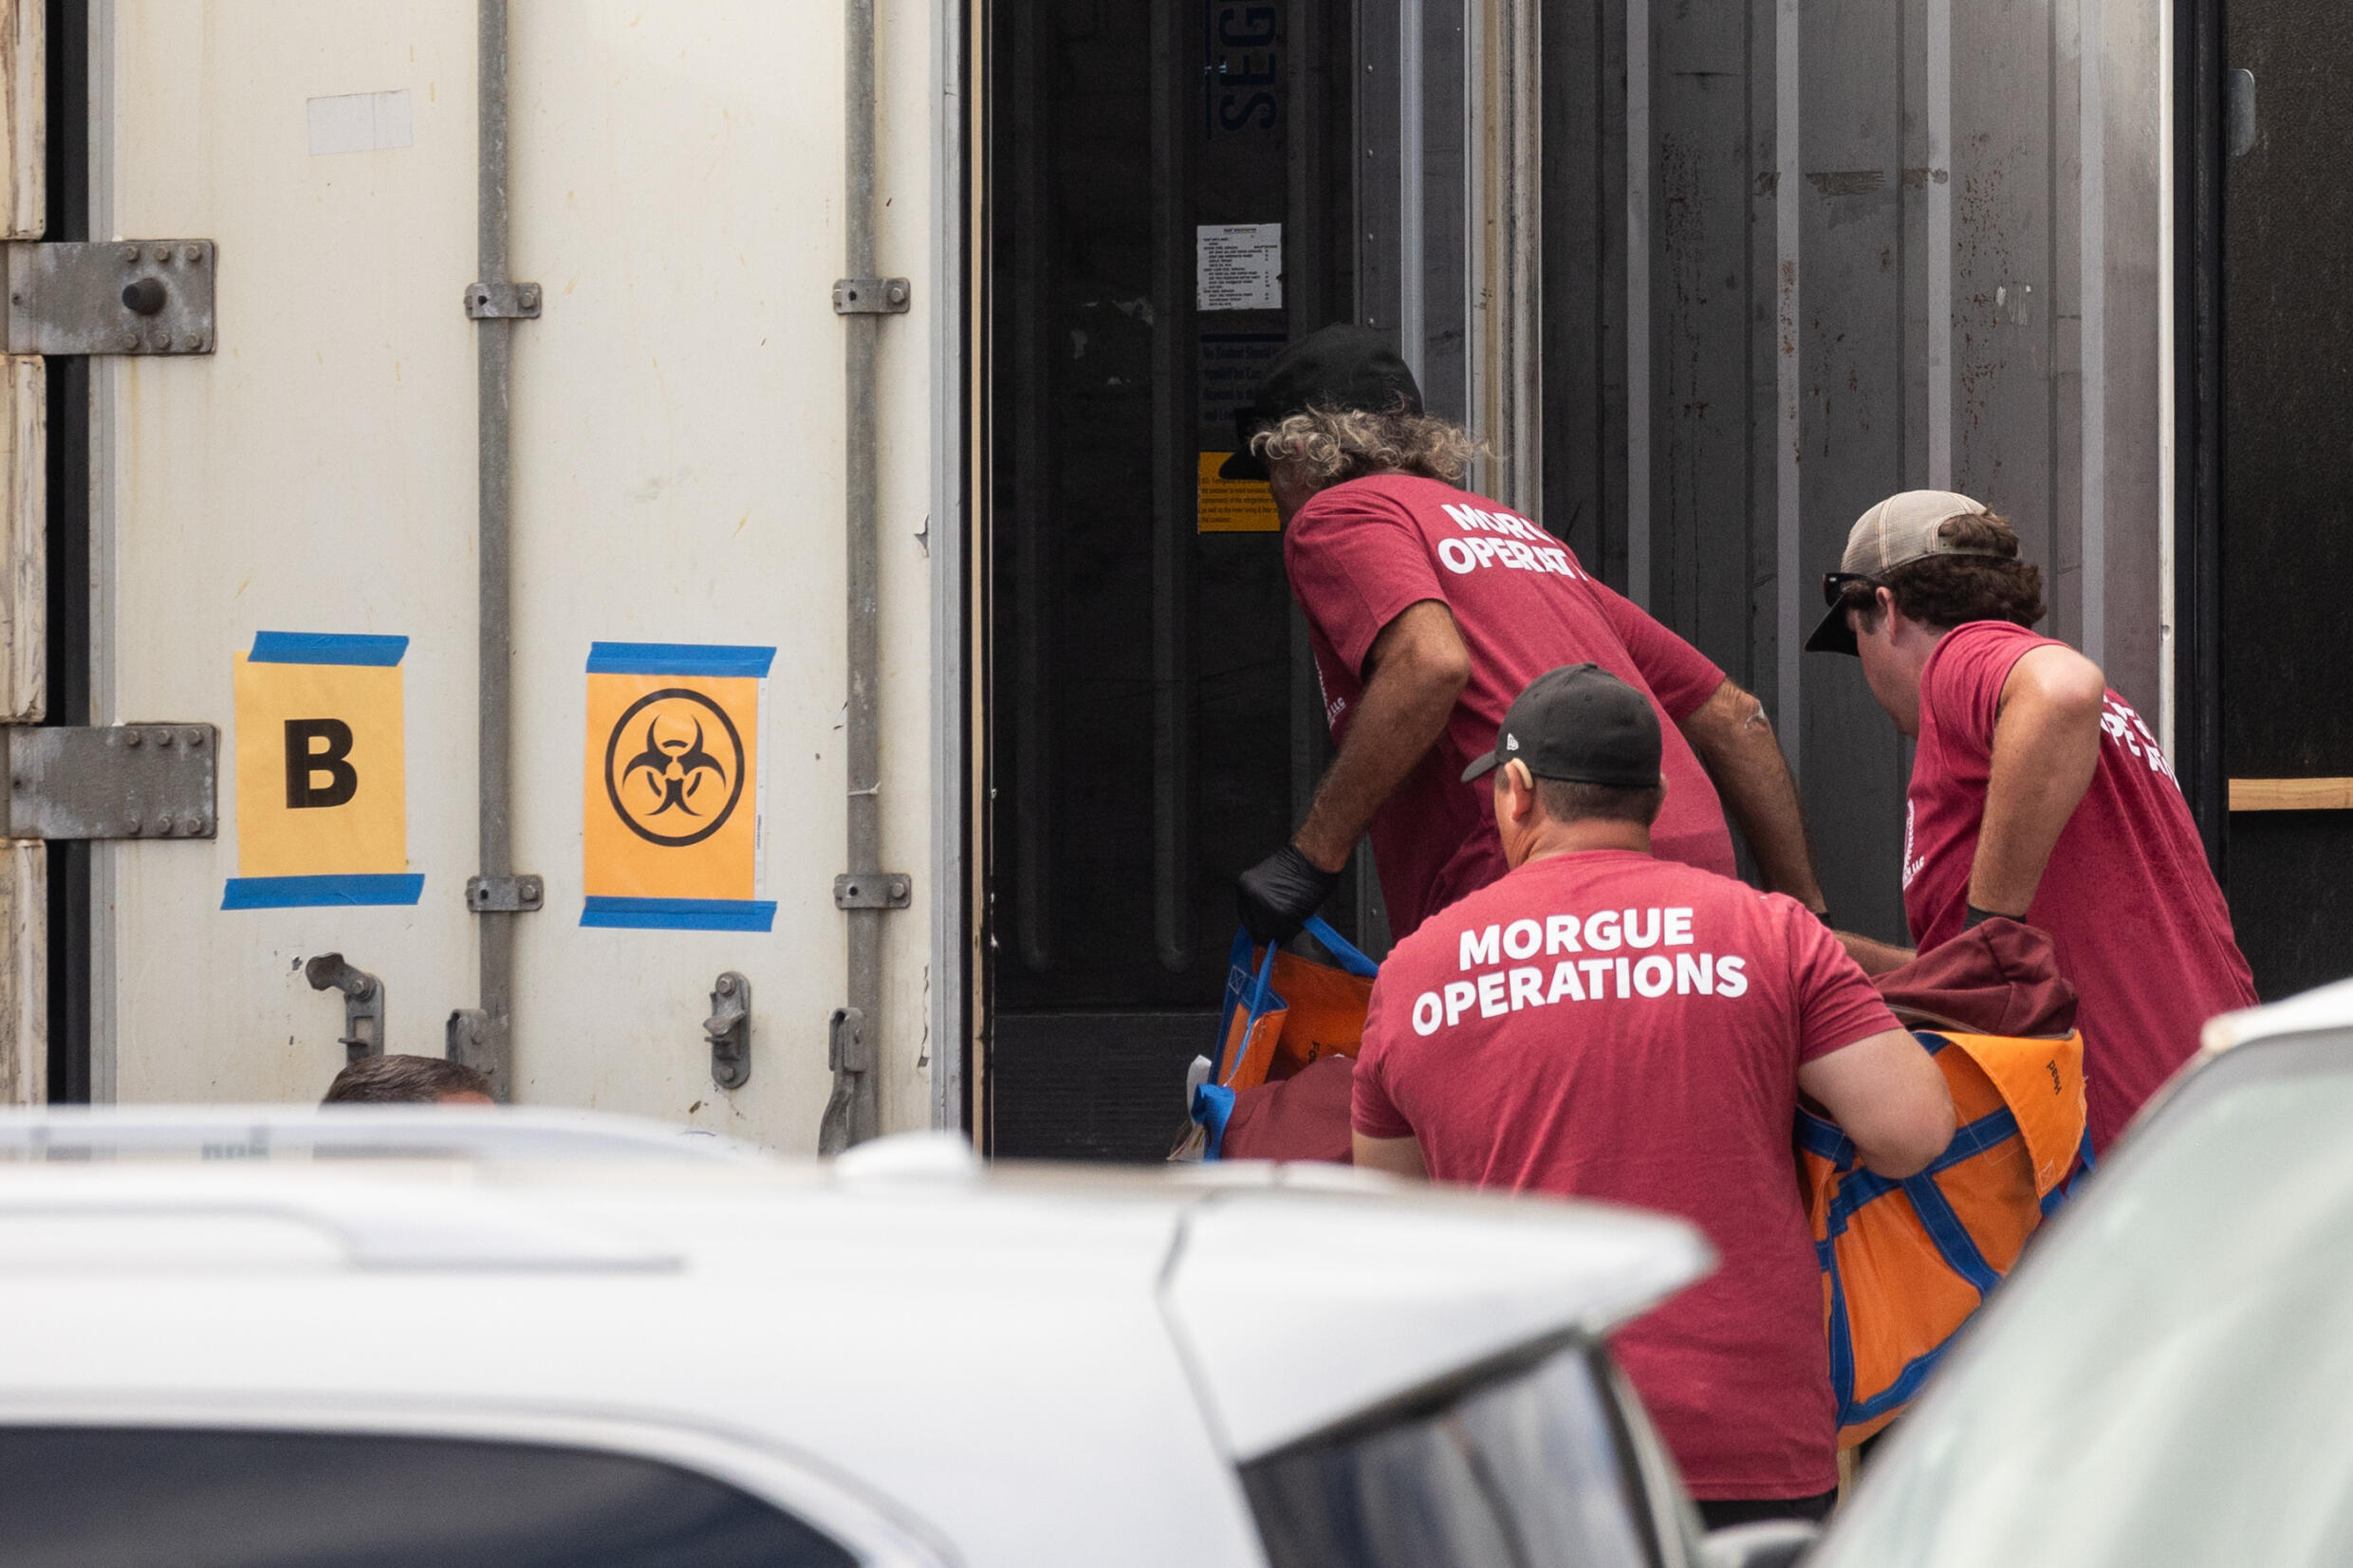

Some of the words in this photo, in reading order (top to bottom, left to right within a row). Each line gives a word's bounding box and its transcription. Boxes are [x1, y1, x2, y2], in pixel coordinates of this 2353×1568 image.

[1218, 0, 1275, 131] SEG
[1437, 537, 1588, 582] OPERAT
[285, 718, 358, 809] B
[1459, 907, 1695, 972] MORGUE
[1412, 953, 1749, 1037] OPERATIONS
